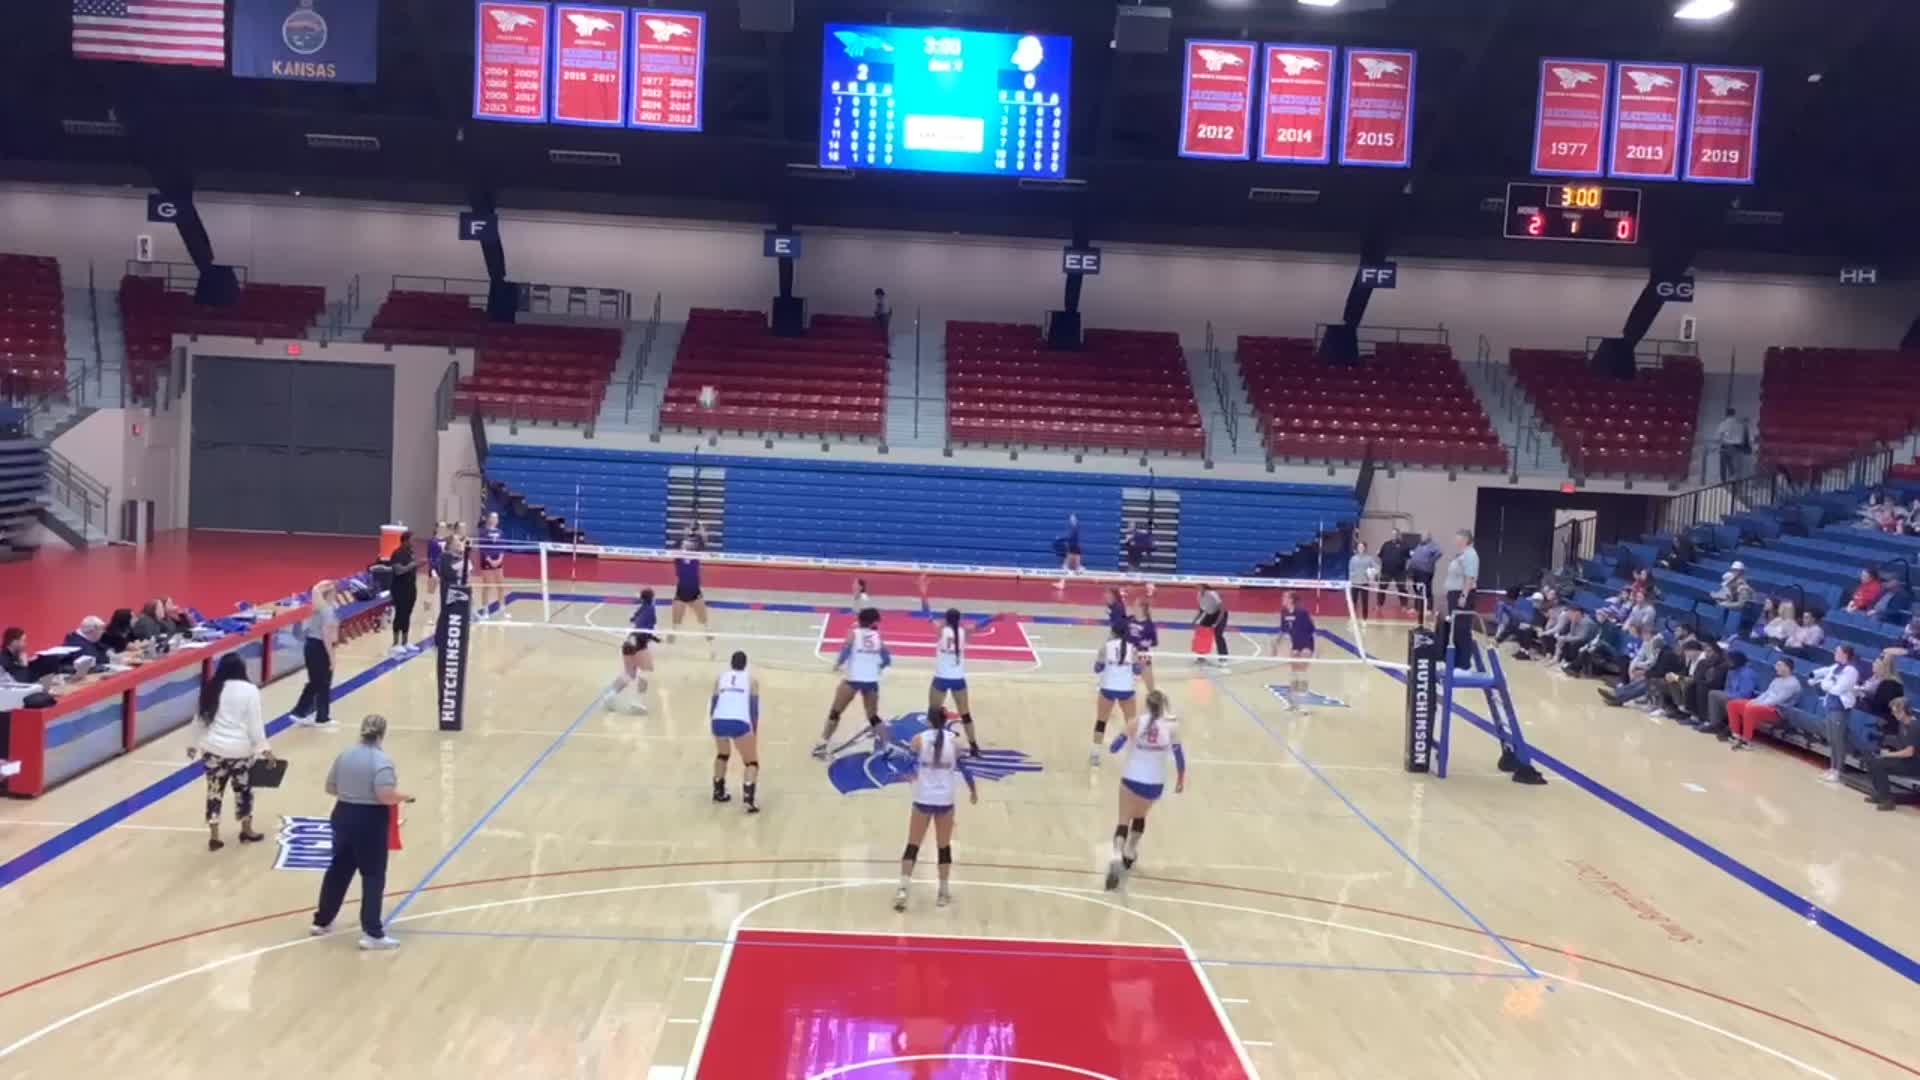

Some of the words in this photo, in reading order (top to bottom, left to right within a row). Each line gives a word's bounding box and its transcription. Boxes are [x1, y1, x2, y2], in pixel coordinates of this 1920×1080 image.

[272, 60, 336, 78] KANSAS
[564, 71, 586, 80] 2015
[592, 73, 616, 82] 2017
[857, 64, 868, 80] 2
[1024, 74, 1036, 89] 0
[1197, 124, 1234, 140] 2012
[1277, 128, 1312, 143] 2014
[1356, 132, 1394, 147] 2015
[1551, 142, 1588, 156] 1977
[1626, 144, 1664, 160] 2013
[1701, 148, 1739, 164] 2019
[158, 202, 177, 218] G
[472, 222, 487, 235] F
[1528, 216, 1542, 235] 2
[1571, 221, 1578, 234] 1
[1618, 220, 1629, 238] 0
[776, 238, 791, 253] E
[1066, 254, 1096, 270] EE
[1362, 268, 1392, 284] FF
[1840, 269, 1876, 284] HH
[1656, 282, 1694, 297] GG
[442, 614, 462, 722] HUTCHINSON
[1414, 659, 1430, 764] HUTCHINSON
